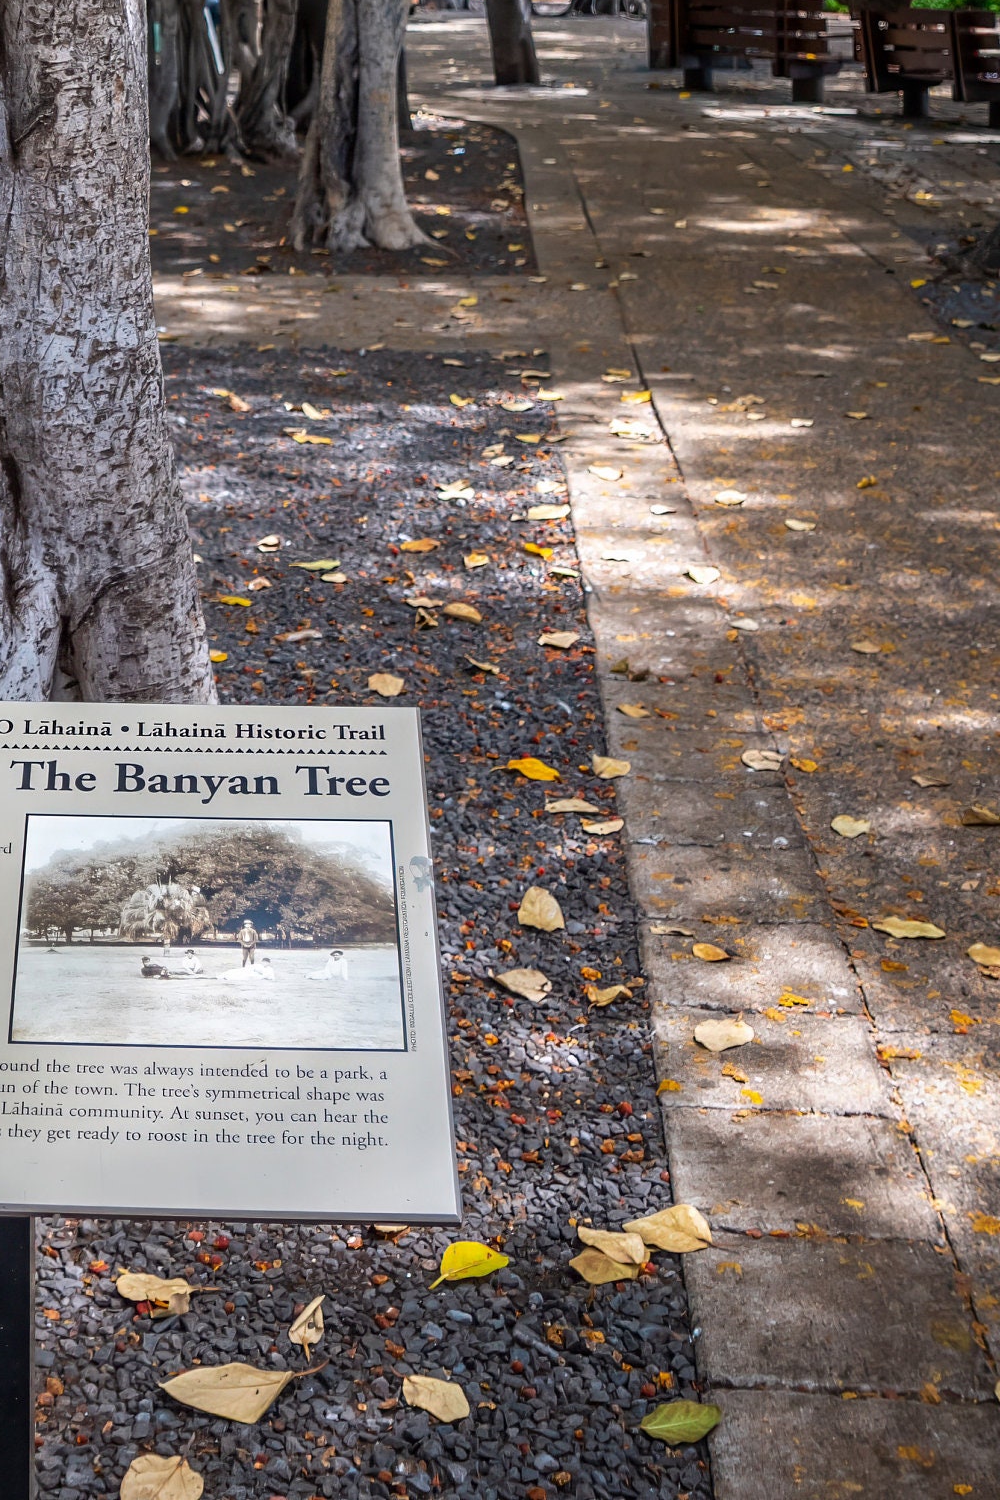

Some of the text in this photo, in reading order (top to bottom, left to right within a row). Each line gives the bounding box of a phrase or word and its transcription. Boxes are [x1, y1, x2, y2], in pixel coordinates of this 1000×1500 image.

[234, 723, 327, 740] Historic
[332, 724, 386, 741] Trail
[9, 759, 391, 805] The Banyan Tree
[46, 1059, 71, 1073] the
[76, 1064, 105, 1074] tree
[110, 1065, 138, 1075] was
[143, 1061, 194, 1081] always
[200, 1063, 269, 1078] intended
[275, 1068, 290, 1079] to
[296, 1064, 315, 1079] be
[320, 1069, 329, 1079] a
[334, 1065, 374, 1084] park,
[379, 1070, 388, 1080] a
[68, 1105, 164, 1123] community.
[169, 1106, 190, 1120] At
[194, 1110, 249, 1123] sunset,
[255, 1112, 284, 1126] you
[290, 1113, 317, 1123] can
[323, 1108, 358, 1124] hear
[363, 1109, 389, 1124] the
[8, 1123, 42, 1143] they
[46, 1129, 71, 1144] get
[77, 1125, 120, 1145] ready
[126, 1130, 142, 1141] to
[148, 1132, 188, 1142] roost
[194, 1129, 209, 1143] in
[215, 1128, 240, 1144] the
[246, 1133, 276, 1145] tree
[282, 1129, 305, 1145] for
[310, 1130, 336, 1146] the
[341, 1131, 389, 1151] night.
